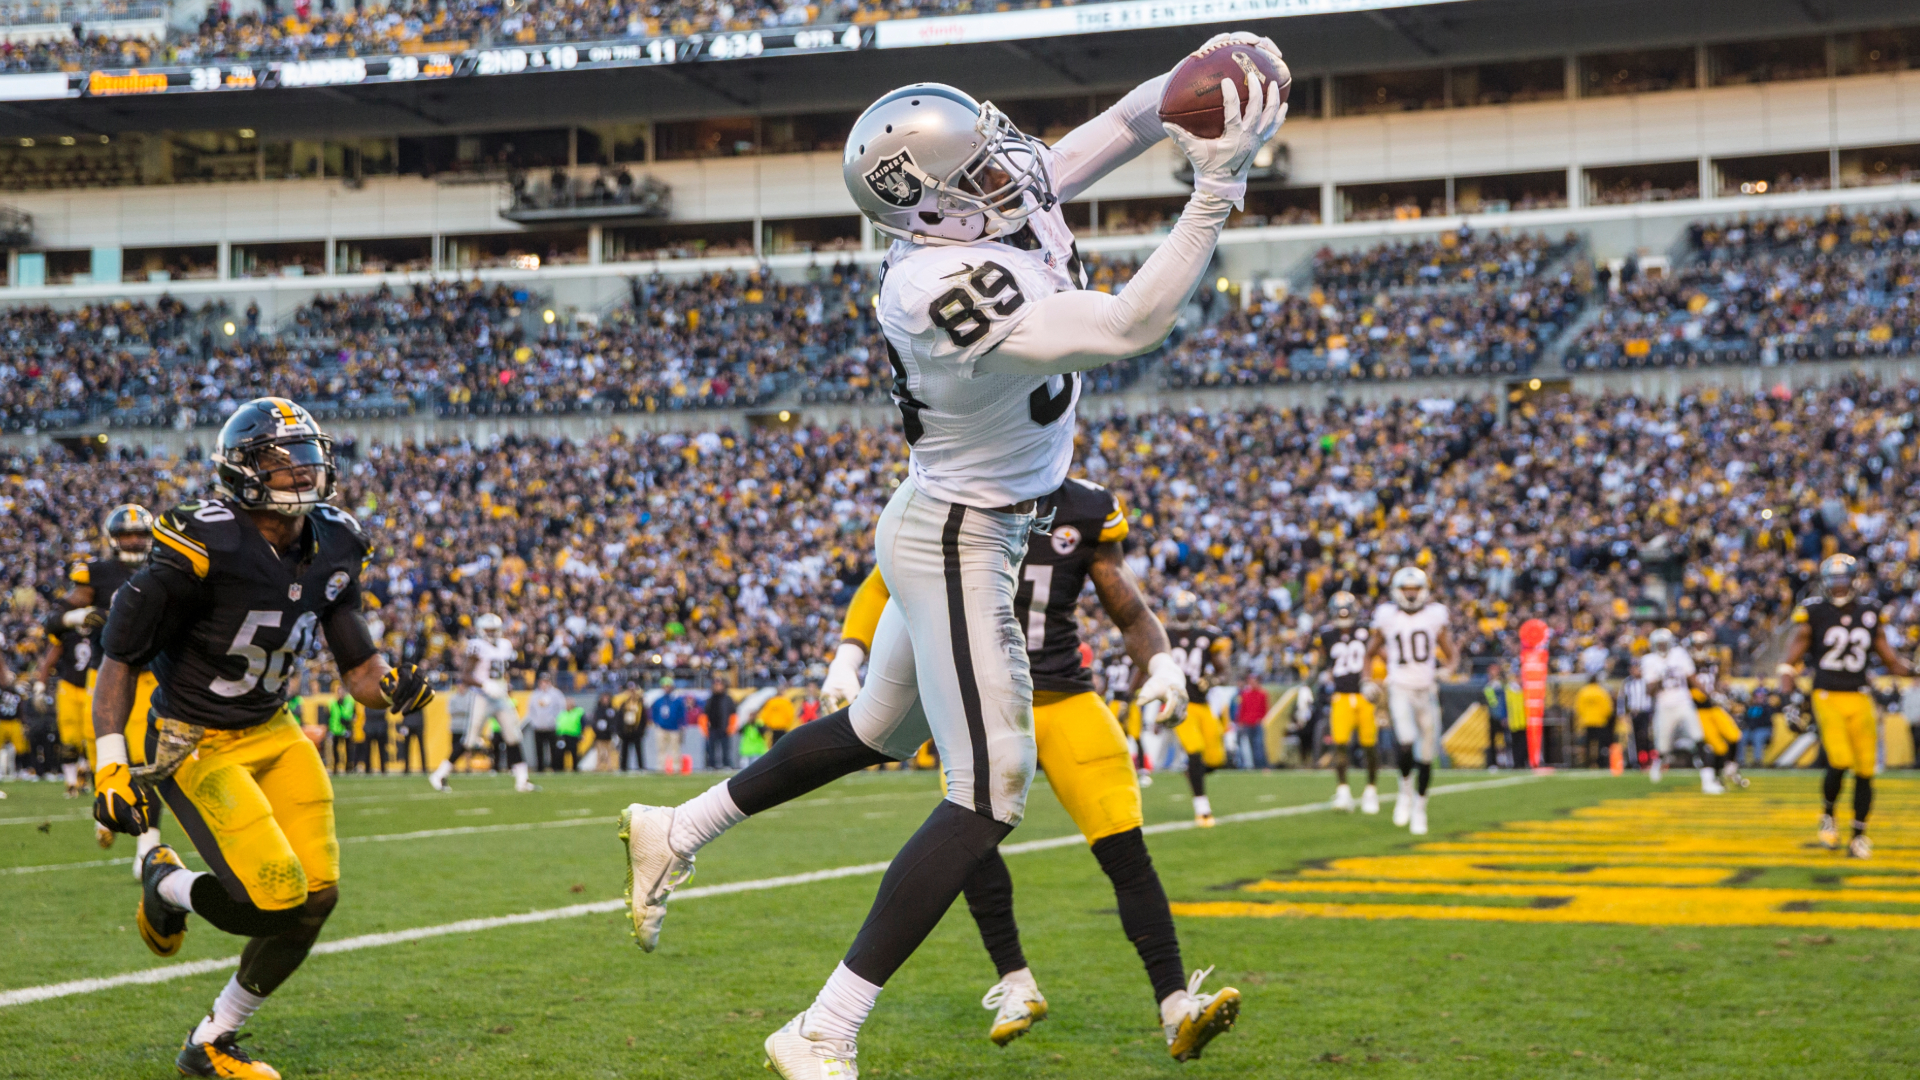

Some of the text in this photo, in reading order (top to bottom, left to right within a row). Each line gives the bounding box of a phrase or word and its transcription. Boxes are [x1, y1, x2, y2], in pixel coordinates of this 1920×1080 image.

[840, 24, 862, 50] 4
[476, 48, 527, 75] 2ND
[646, 38, 676, 63] 11
[869, 155, 905, 182] RAIDERS
[929, 261, 1025, 348] 89
[208, 610, 318, 698] 50
[1395, 631, 1430, 665] 10
[1819, 625, 1871, 673] 23
